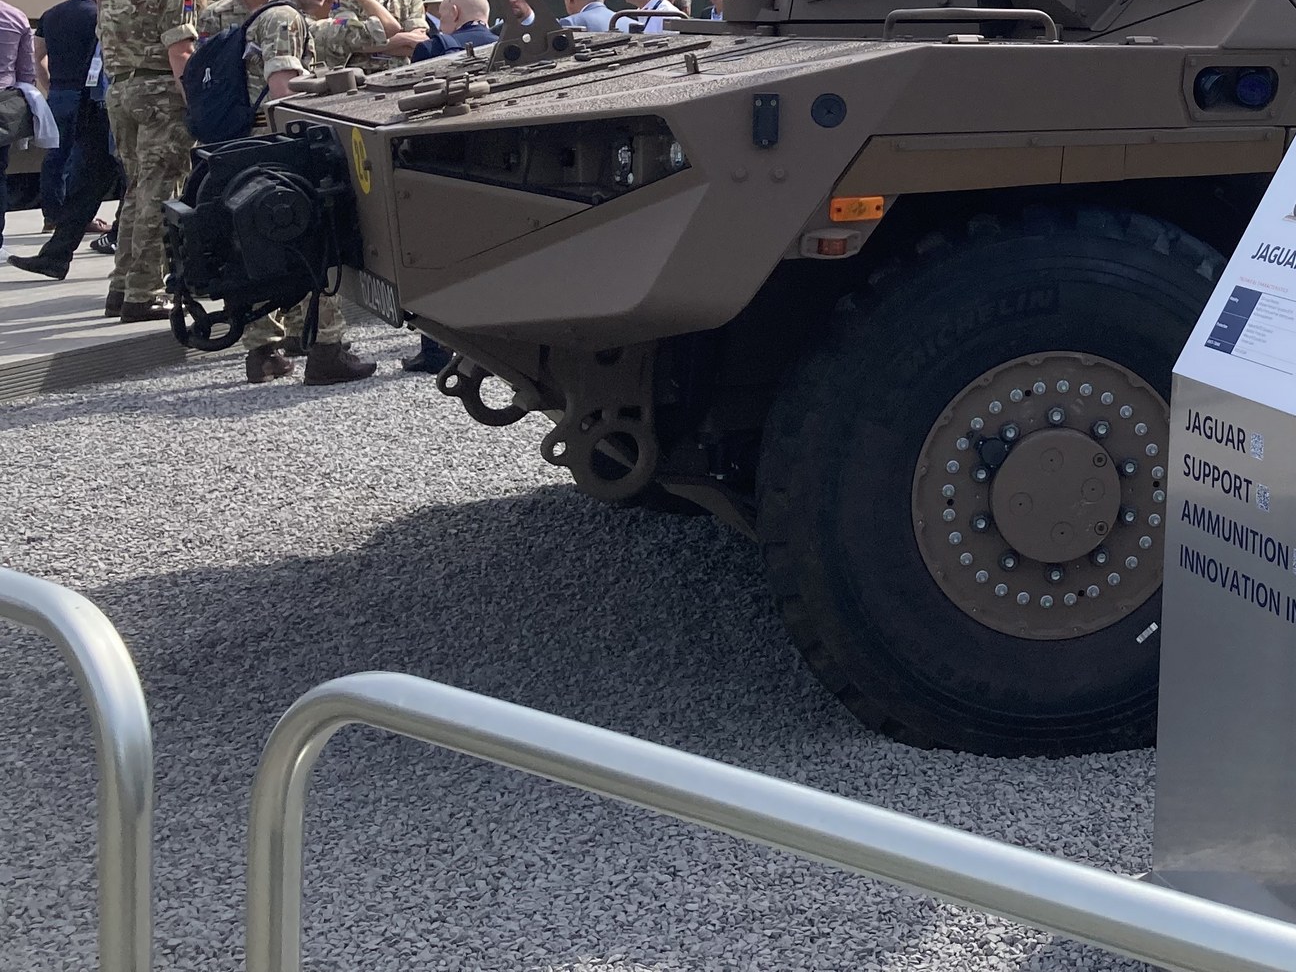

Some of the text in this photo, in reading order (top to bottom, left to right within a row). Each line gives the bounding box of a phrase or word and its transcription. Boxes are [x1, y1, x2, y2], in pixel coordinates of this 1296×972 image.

[1185, 408, 1246, 454] JAGUAR
[1183, 453, 1252, 503] SUPPORT
[1181, 499, 1289, 570] AMMUNITION
[1179, 544, 1281, 616] INNOVATION
